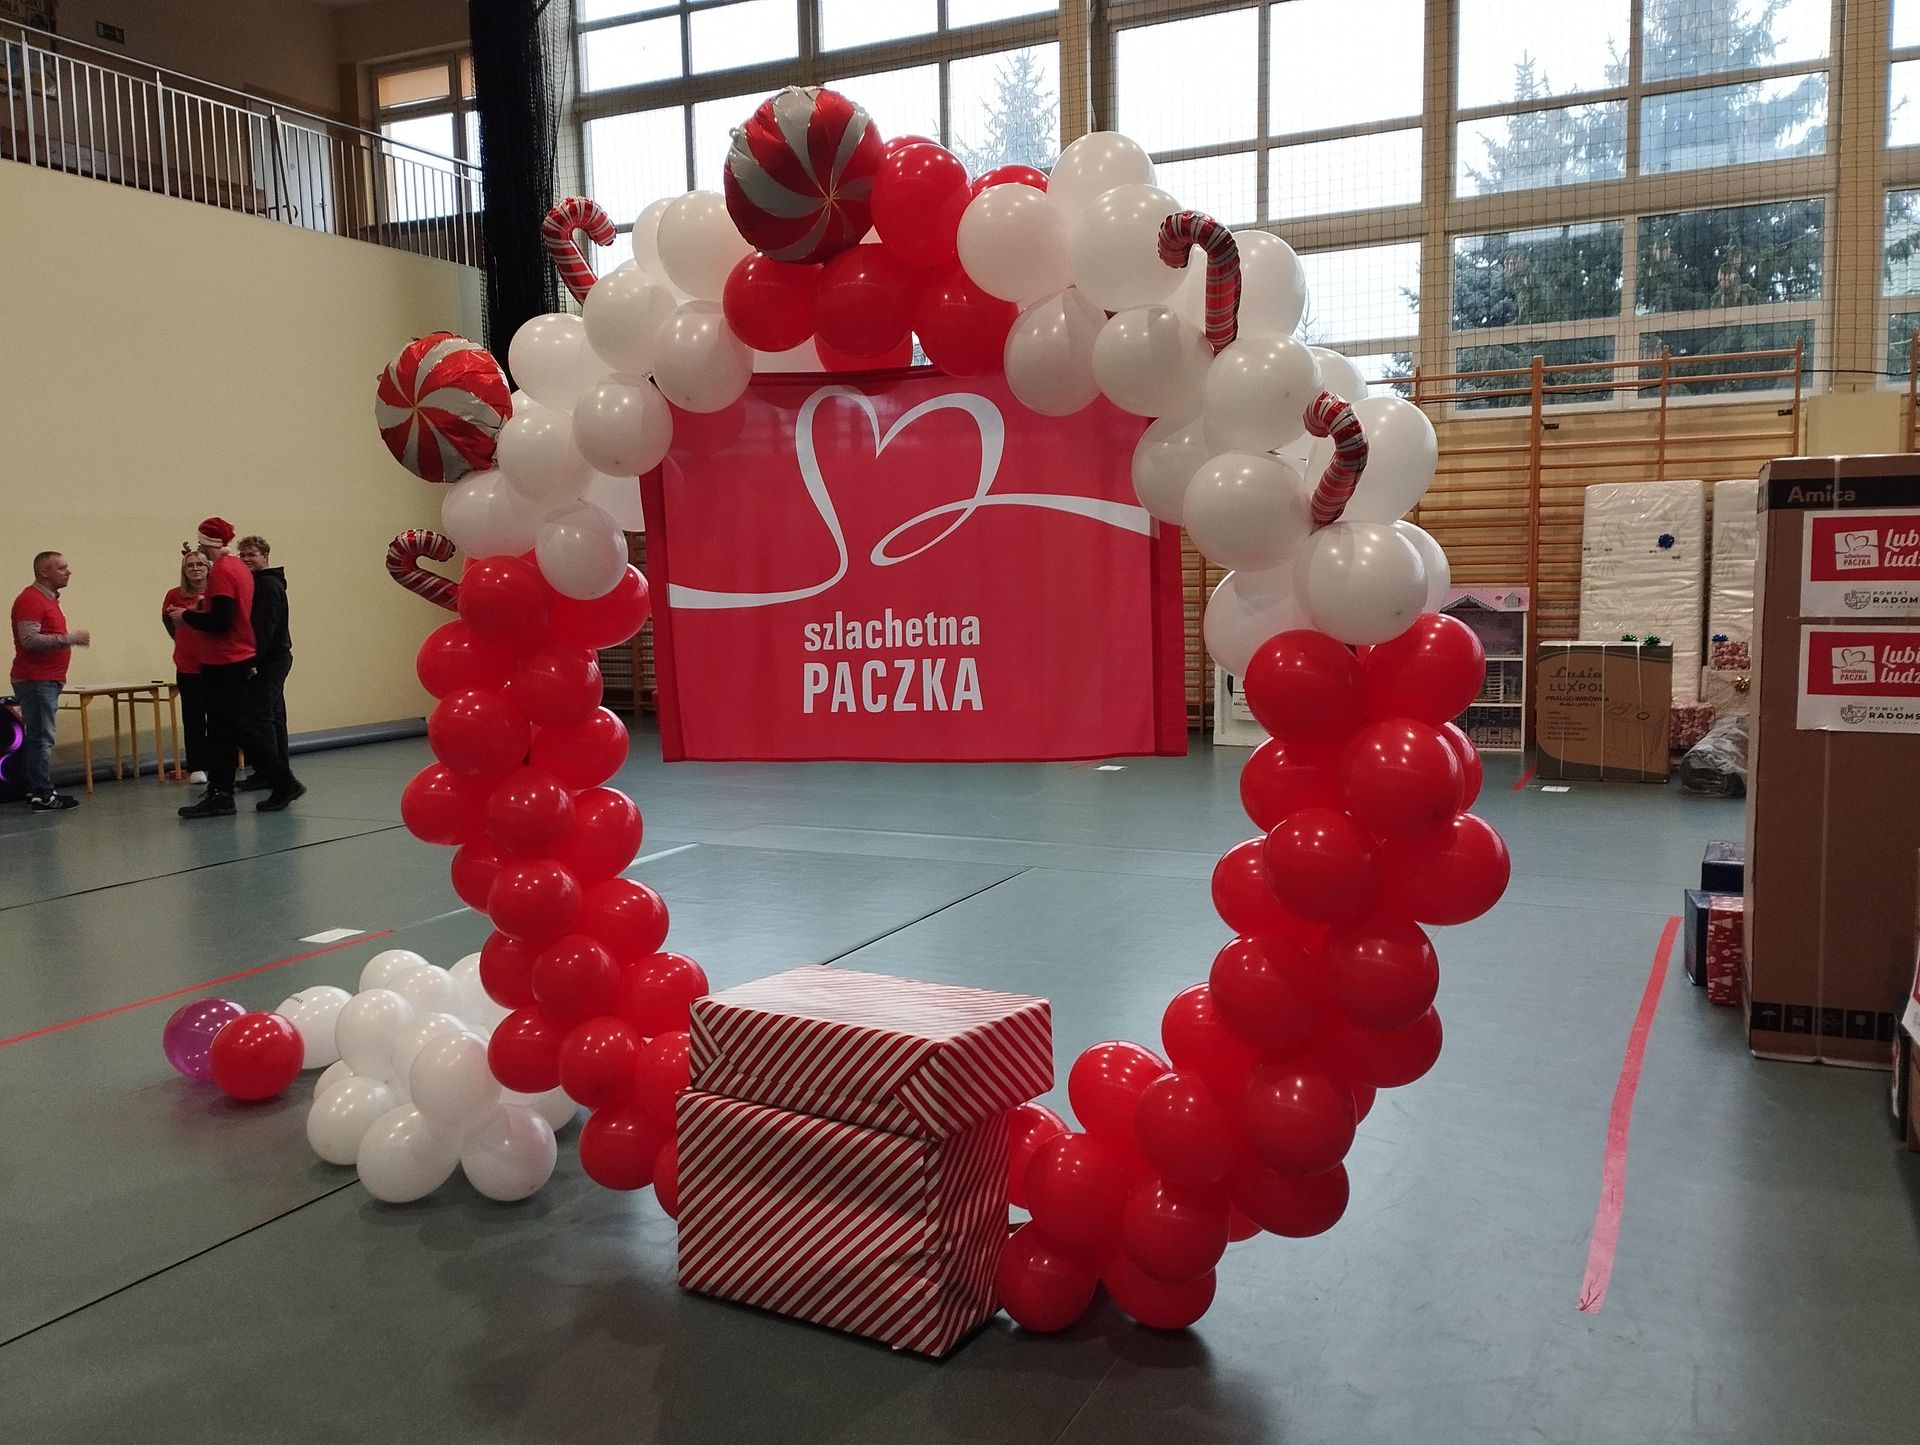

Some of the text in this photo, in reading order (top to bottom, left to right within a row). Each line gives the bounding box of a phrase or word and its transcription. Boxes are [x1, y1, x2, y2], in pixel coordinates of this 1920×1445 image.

[1787, 484, 1856, 503] Amica
[1884, 528, 1920, 552] Lub
[1884, 551, 1920, 568] lud
[803, 608, 980, 651] szlachetna
[1550, 666, 1604, 678] Lusia
[1840, 673, 1868, 681] PACZKA
[803, 657, 984, 714] PACZKA
